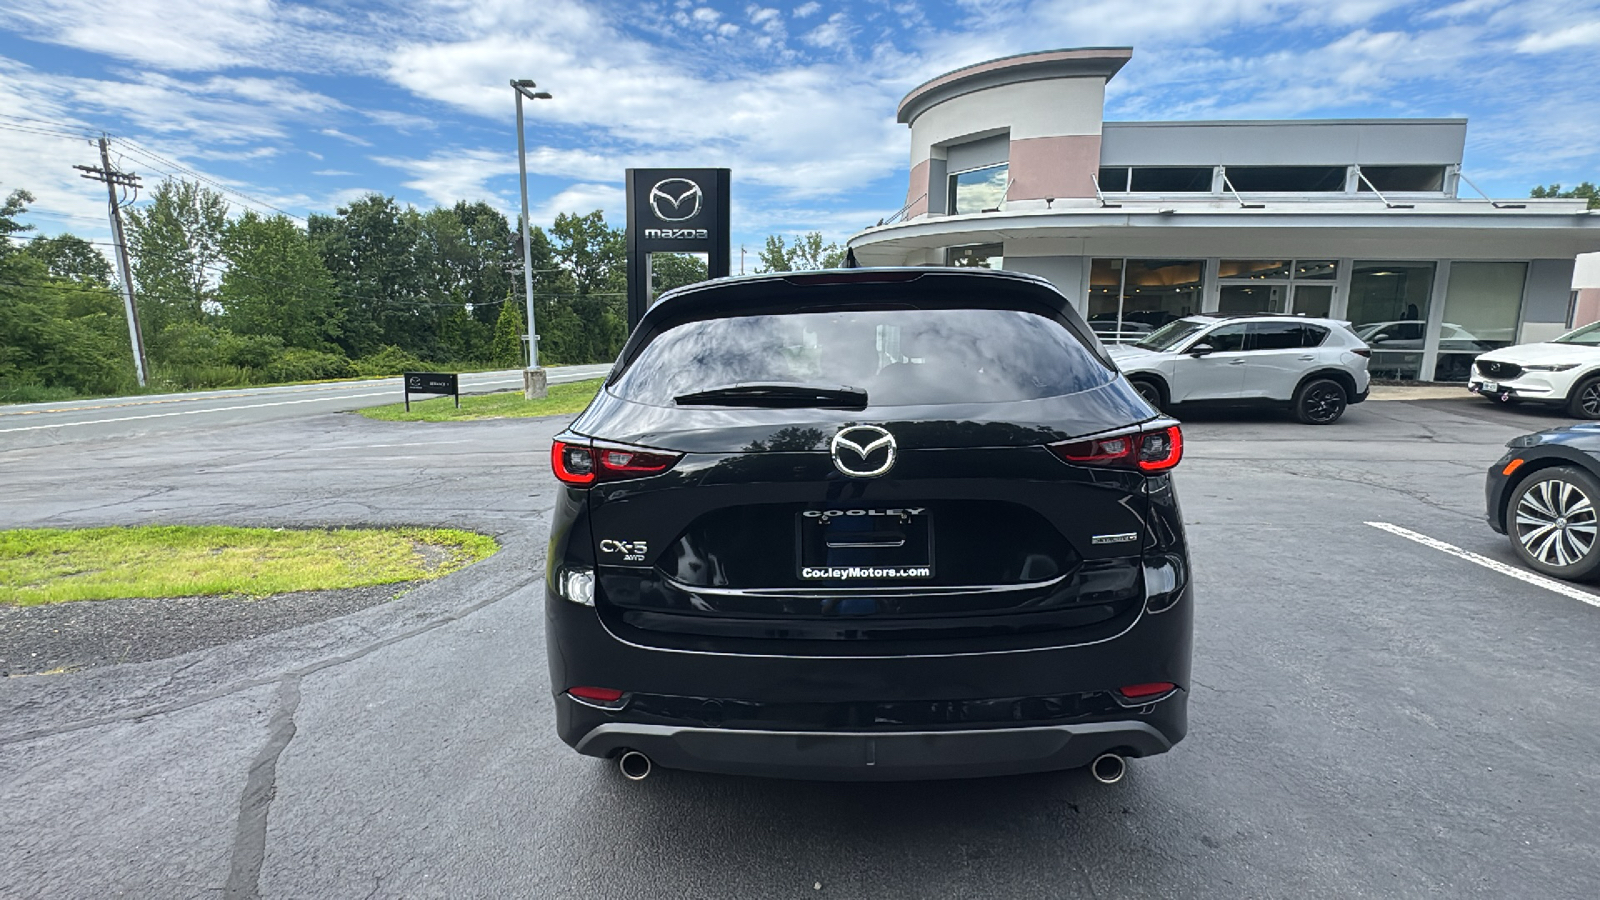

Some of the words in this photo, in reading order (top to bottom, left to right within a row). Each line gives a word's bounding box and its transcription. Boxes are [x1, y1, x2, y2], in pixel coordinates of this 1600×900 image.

[803, 507, 925, 517] COOLEY
[600, 540, 648, 554] CX-5
[802, 567, 930, 580] CooleyMotors.com
